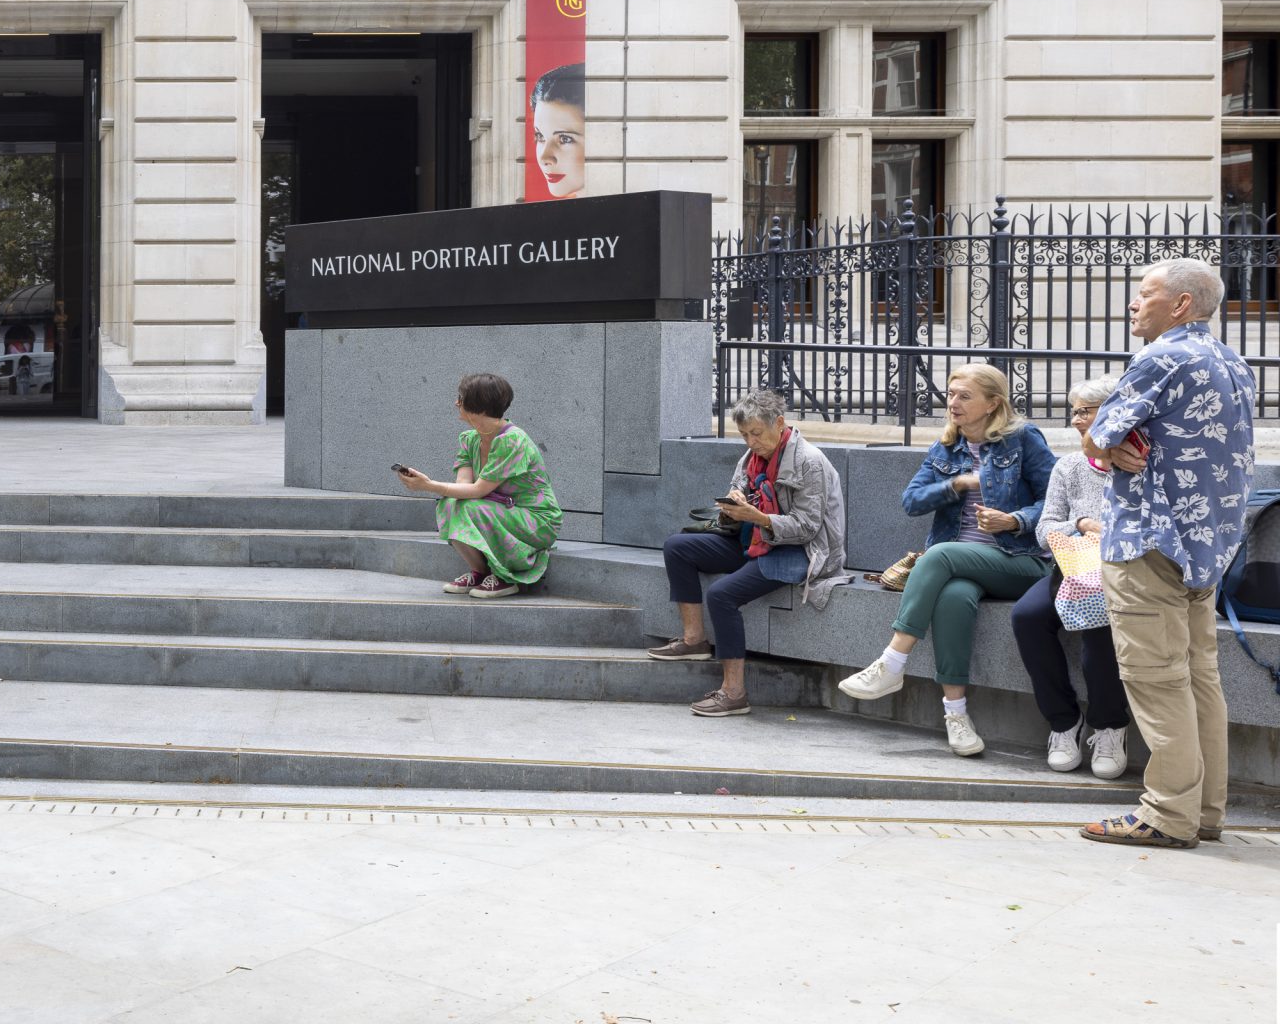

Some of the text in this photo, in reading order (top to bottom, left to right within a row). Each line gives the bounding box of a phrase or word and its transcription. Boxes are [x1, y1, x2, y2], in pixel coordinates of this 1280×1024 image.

[311, 235, 620, 277] NATIONAL PORTRAIT GALLERY
